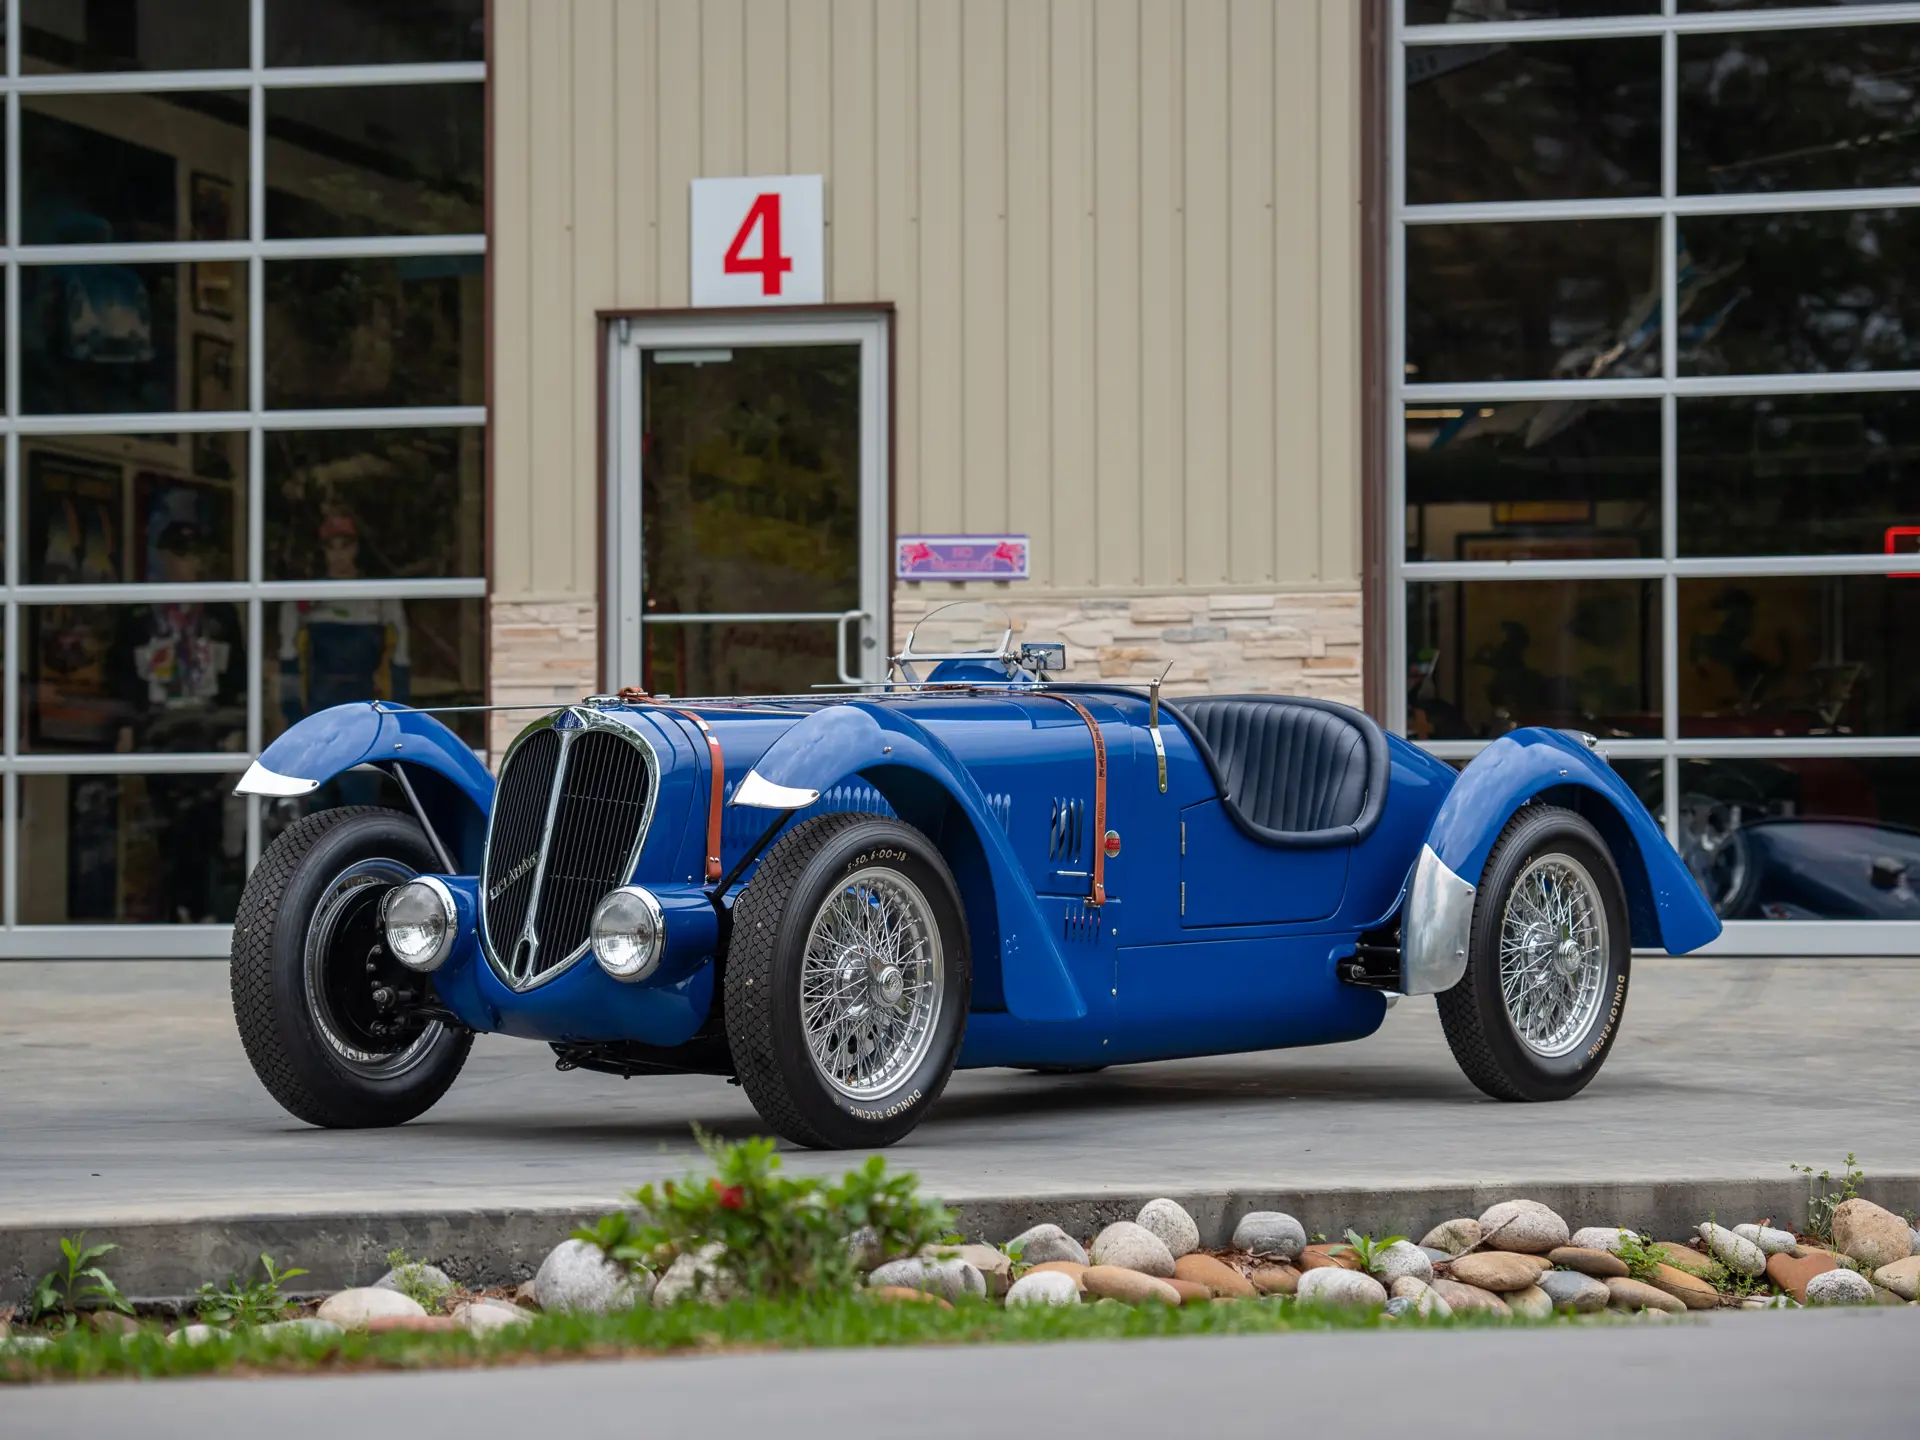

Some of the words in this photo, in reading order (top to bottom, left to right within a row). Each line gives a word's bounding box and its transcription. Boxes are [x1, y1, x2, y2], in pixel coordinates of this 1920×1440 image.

[724, 192, 793, 295] 4
[1608, 974, 1626, 1023] DUNLOP
[1587, 1023, 1612, 1059] RACING
[848, 1105, 884, 1119] RACING
[886, 1088, 922, 1117] DUNLOP
